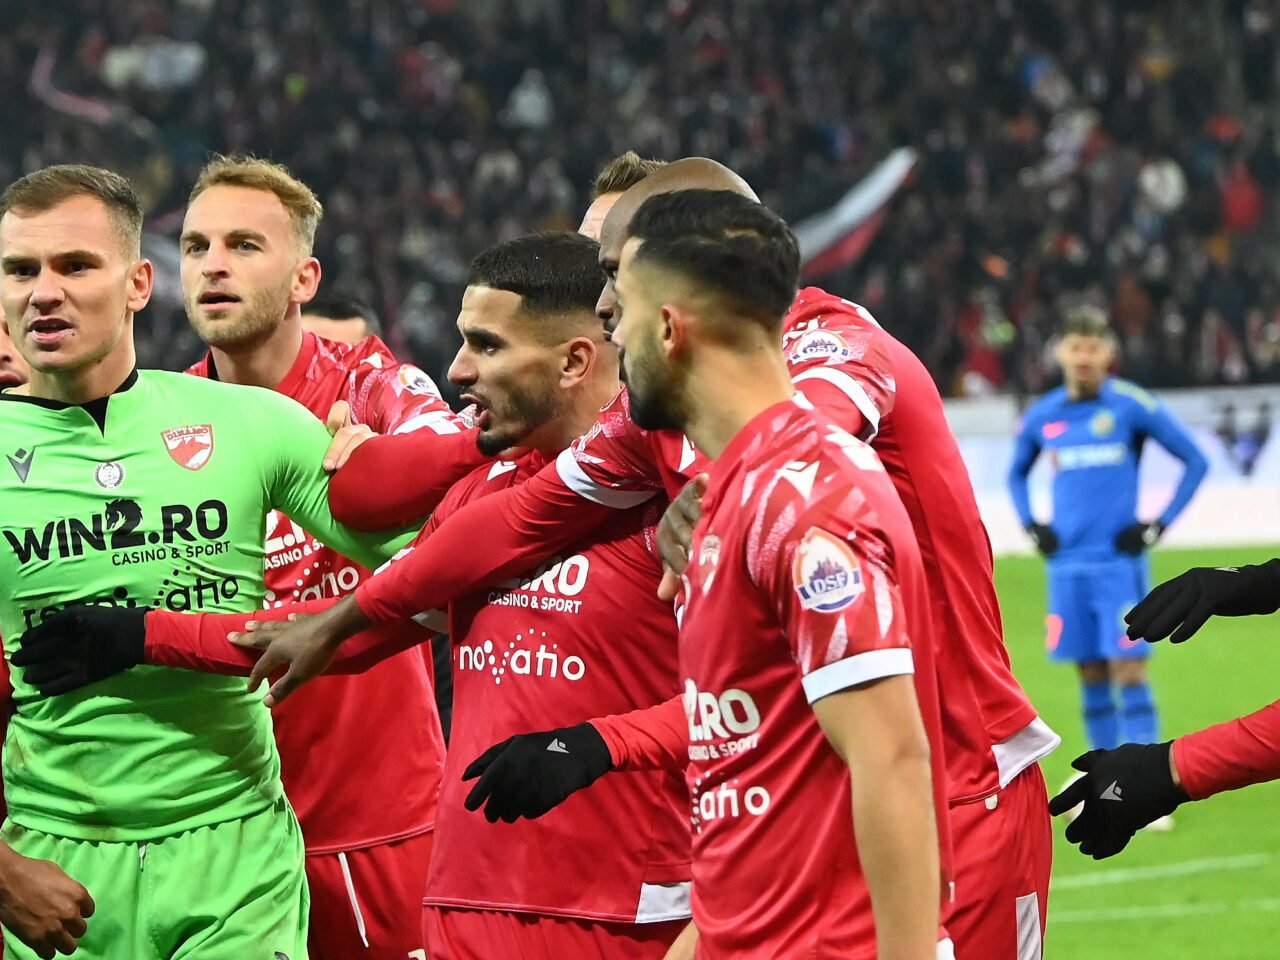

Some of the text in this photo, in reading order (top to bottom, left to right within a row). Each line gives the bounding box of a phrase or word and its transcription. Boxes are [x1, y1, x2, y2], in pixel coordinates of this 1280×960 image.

[2, 498, 229, 566] WIN2.RO
[111, 540, 232, 567] CASINO & SPORT
[262, 548, 303, 571] ASINO
[488, 592, 583, 614] CASINO & SPORT
